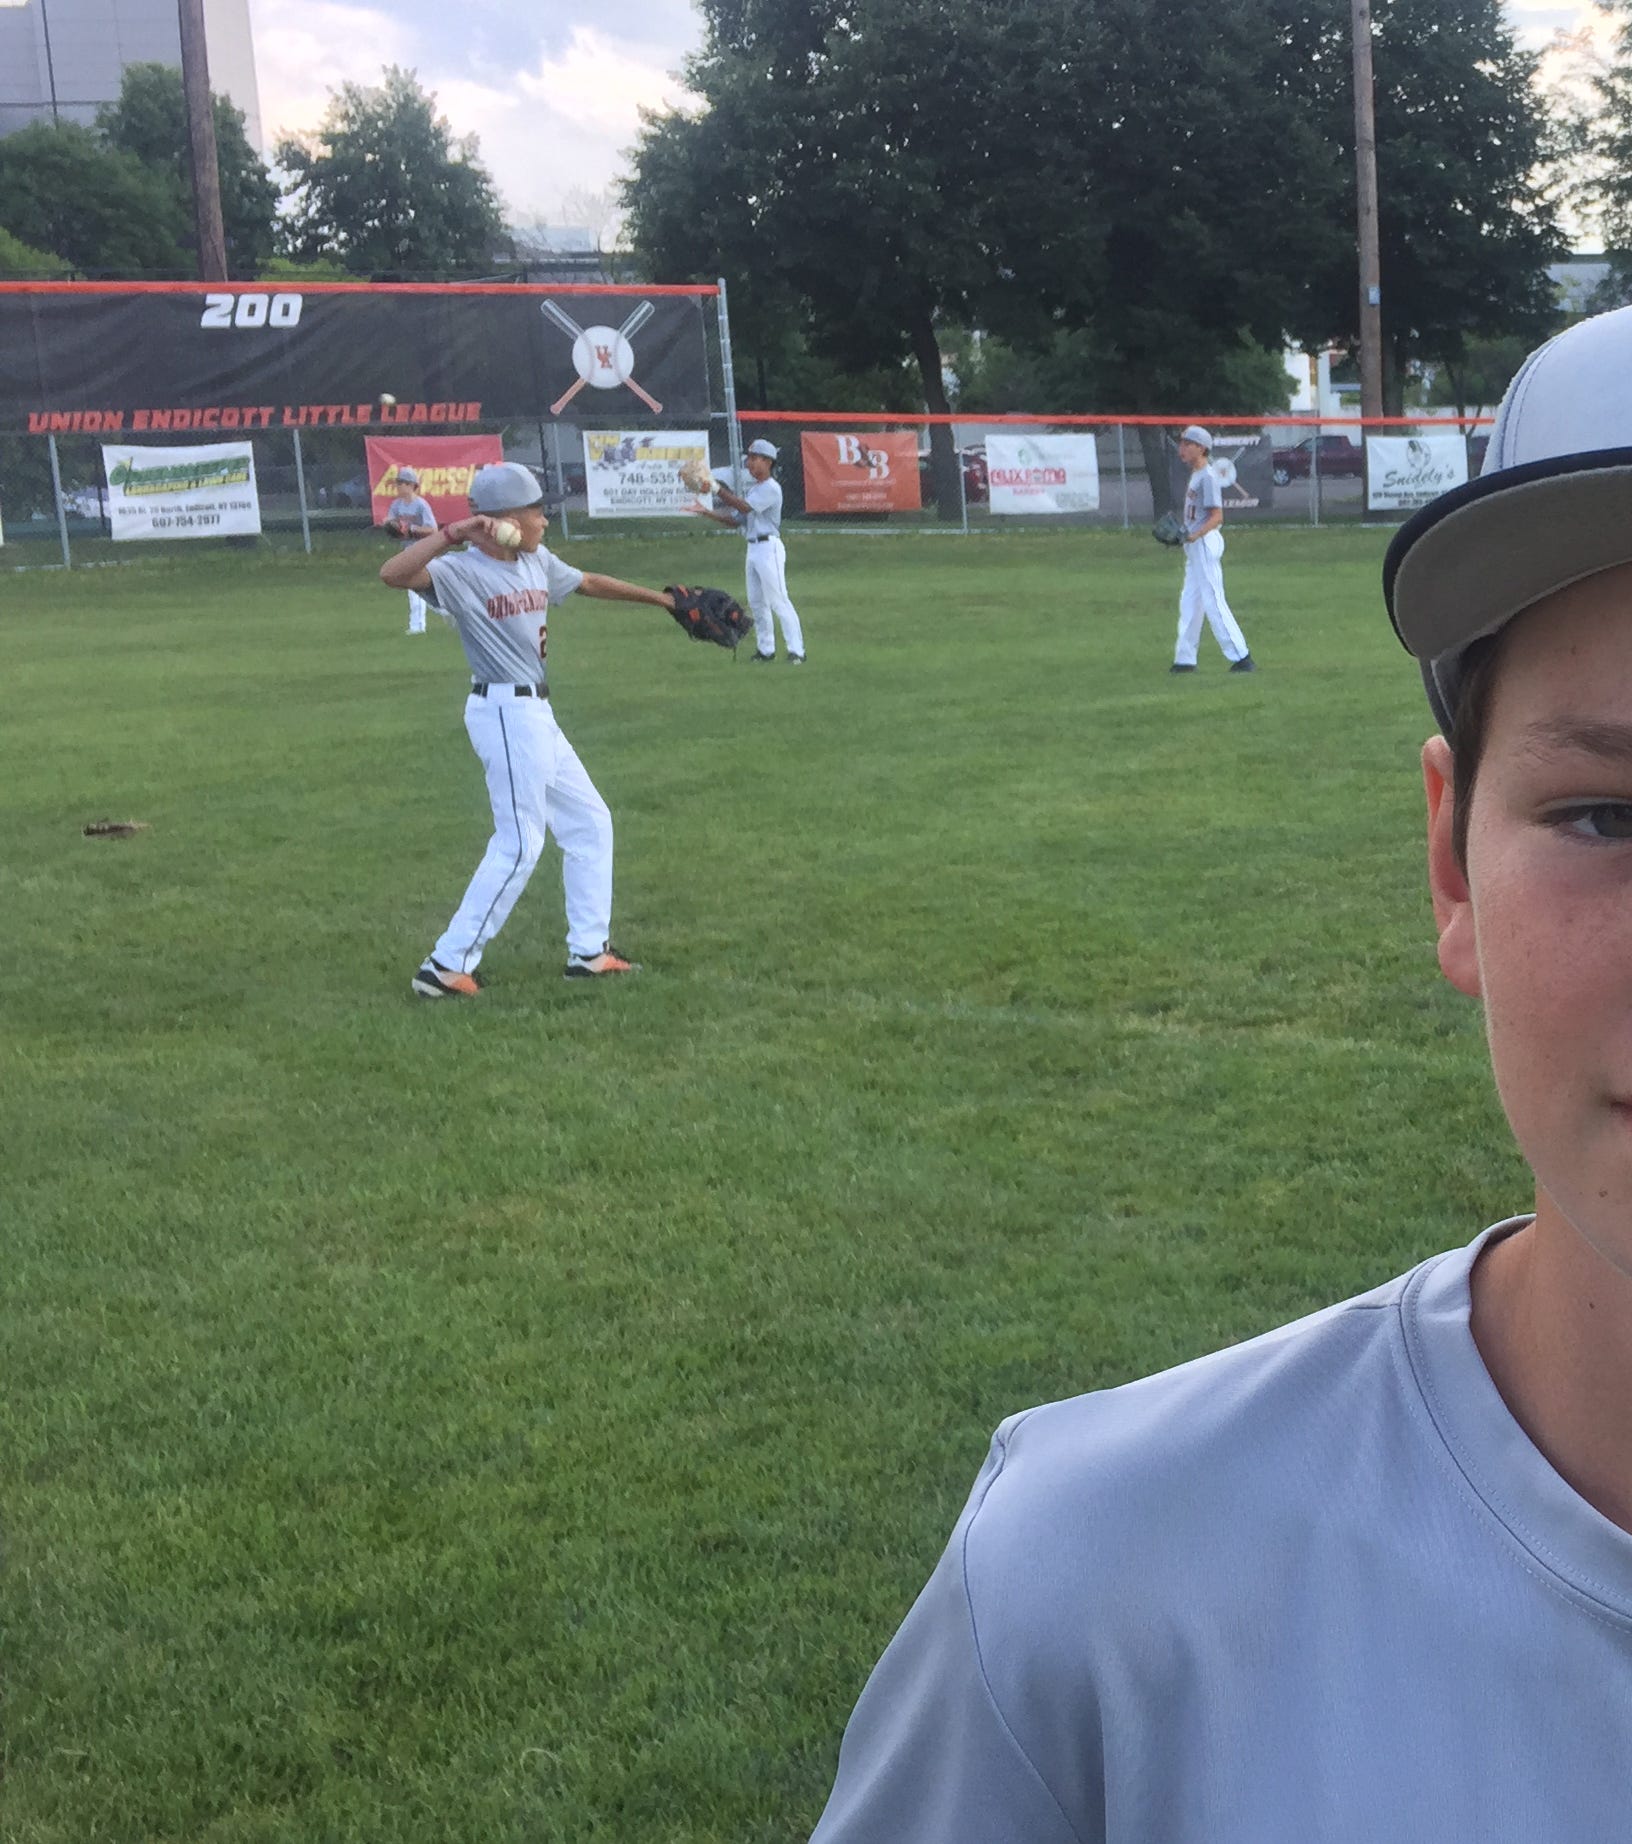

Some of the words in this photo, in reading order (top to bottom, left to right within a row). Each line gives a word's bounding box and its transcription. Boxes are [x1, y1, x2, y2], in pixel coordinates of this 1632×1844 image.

[201, 293, 303, 329] 200
[28, 410, 124, 433] UNION
[132, 406, 276, 430] ENDICOTT
[282, 403, 373, 426] LITTLE
[380, 402, 482, 423] LEAGUE
